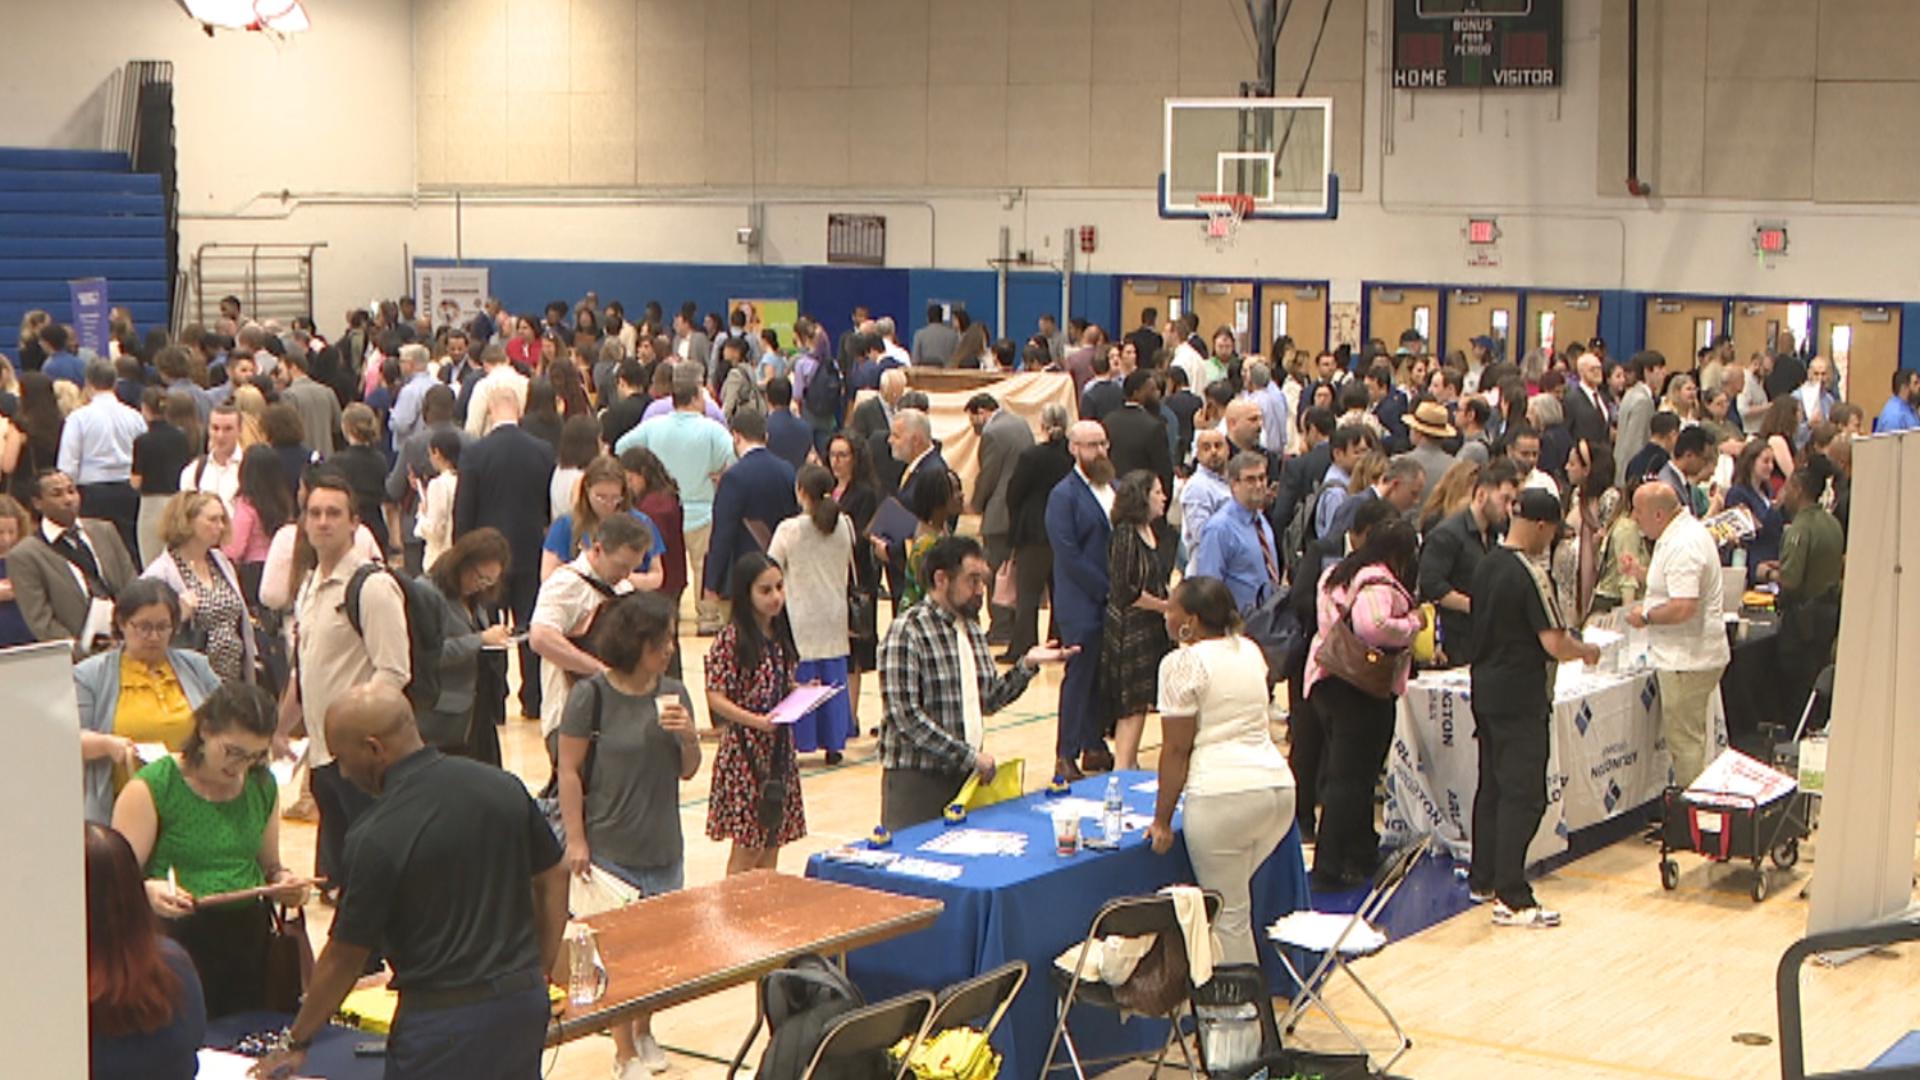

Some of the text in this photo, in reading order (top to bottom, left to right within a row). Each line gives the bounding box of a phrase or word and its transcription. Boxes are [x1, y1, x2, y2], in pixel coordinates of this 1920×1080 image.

[1453, 19, 1493, 32] BONUS
[1454, 44, 1492, 56] PERIOD
[1394, 69, 1447, 87] HOME
[1492, 68, 1554, 85] VISITOR
[1591, 751, 1637, 778] ARLINGON
